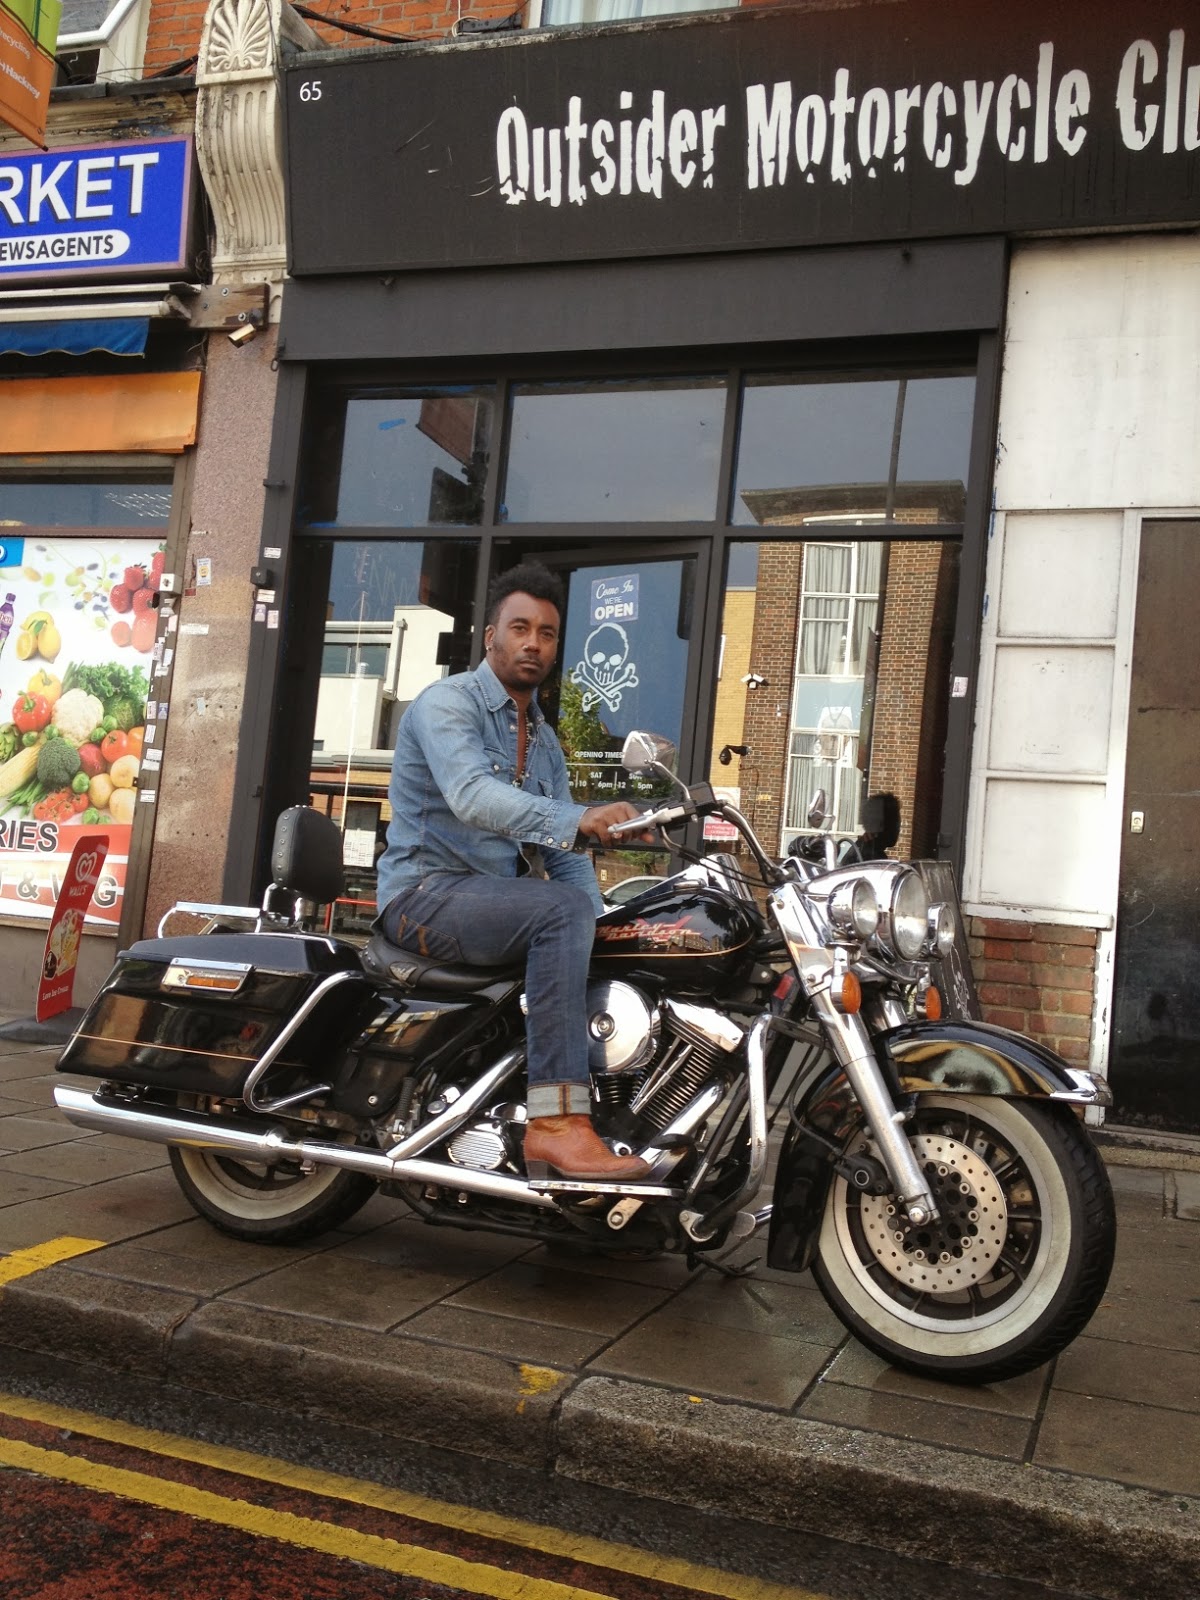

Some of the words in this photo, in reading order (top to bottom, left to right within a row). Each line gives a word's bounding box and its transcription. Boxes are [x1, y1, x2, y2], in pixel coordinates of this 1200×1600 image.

[300, 81, 321, 101] 65
[496, 88, 726, 207] Outsider
[746, 41, 1090, 186] Motorcycle
[0, 152, 160, 224] RKET
[0, 234, 114, 261] EWSAGENTS
[596, 583, 619, 599] Come
[595, 602, 634, 620] OPEN
[590, 771, 602, 779] SAT
[597, 781, 613, 789] 6pm
